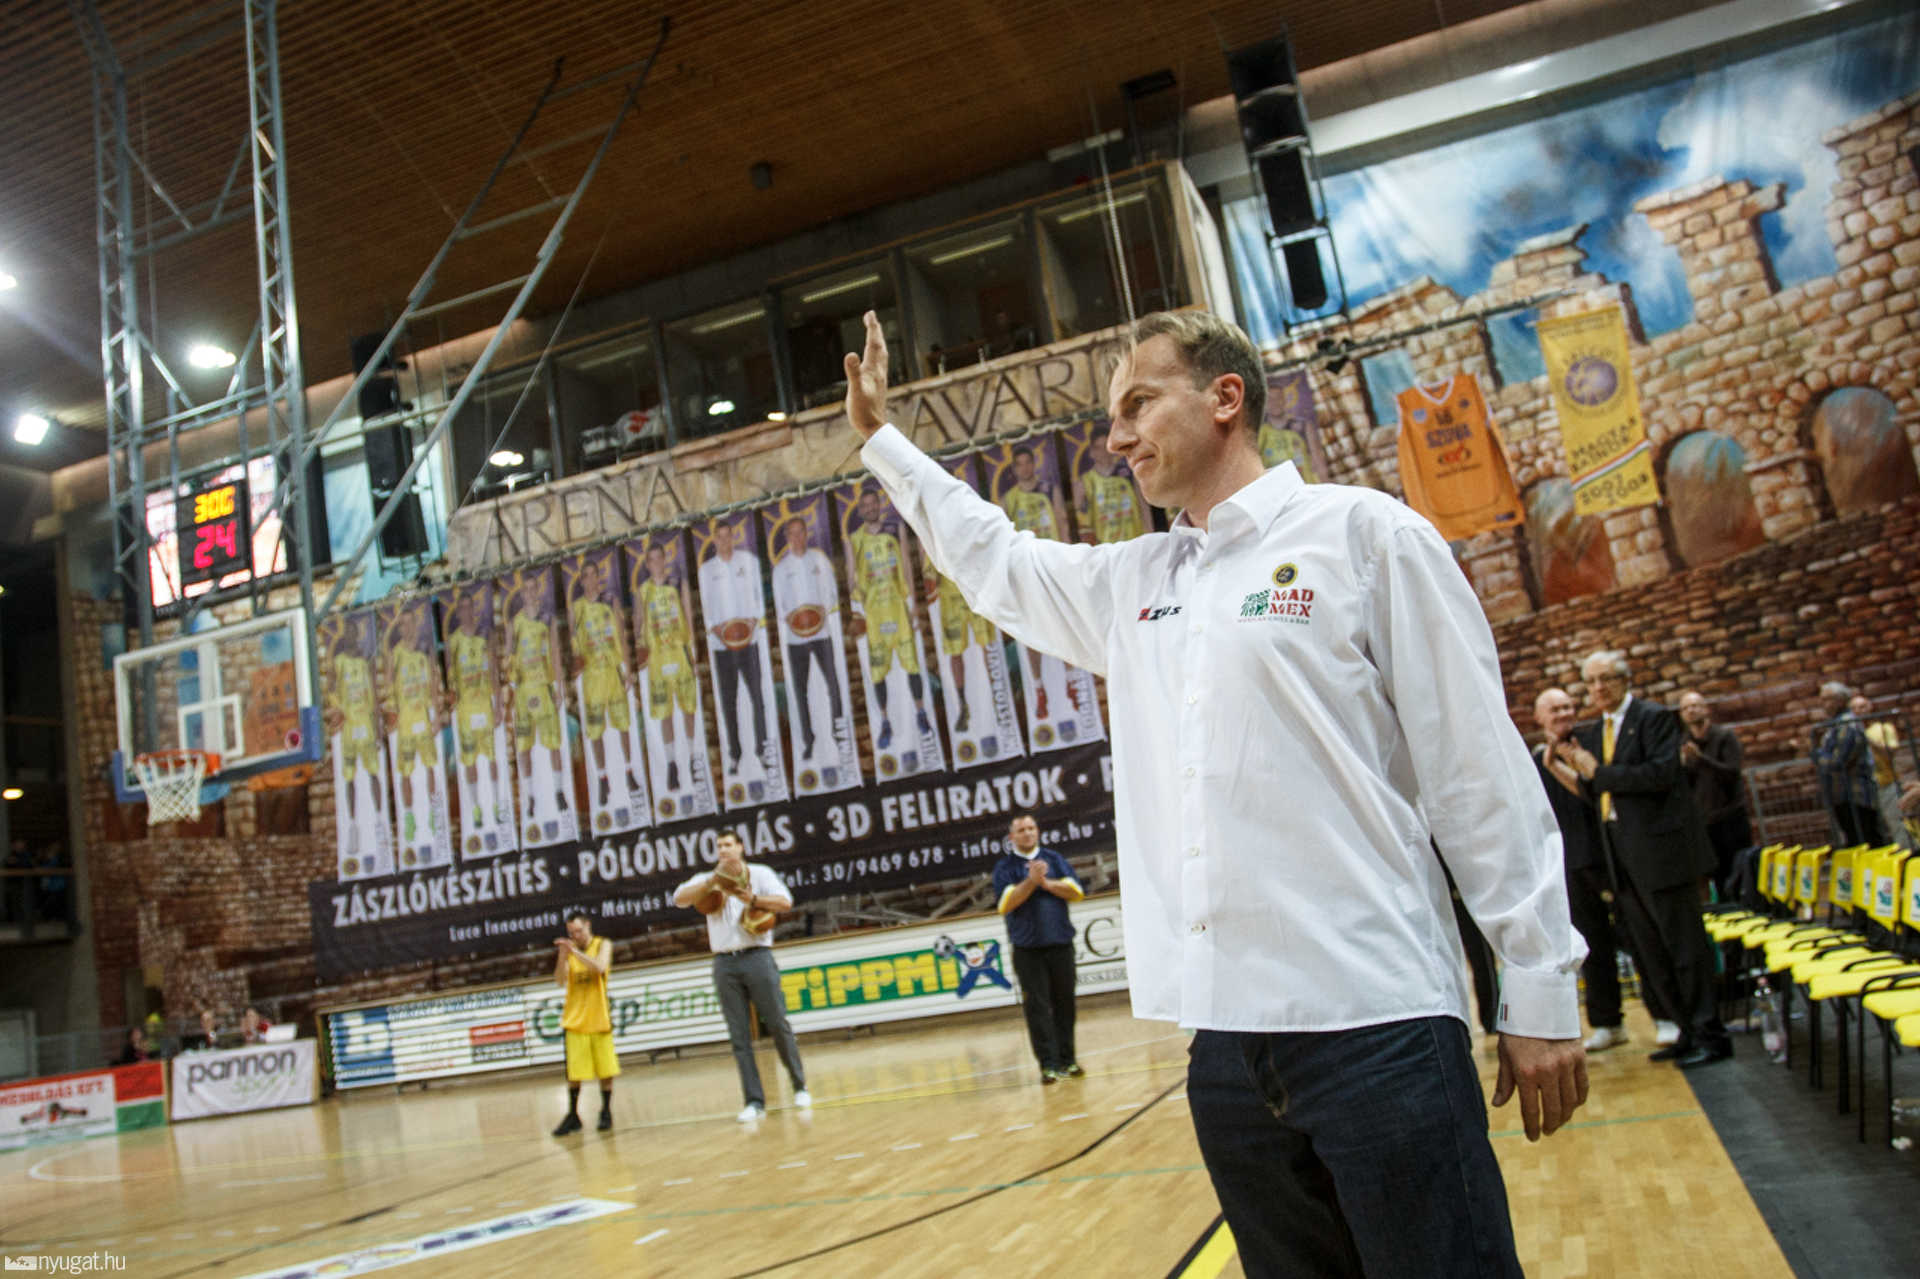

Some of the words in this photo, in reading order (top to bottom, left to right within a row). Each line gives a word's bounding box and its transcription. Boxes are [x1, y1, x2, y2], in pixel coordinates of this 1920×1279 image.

[481, 466, 688, 566] ARENA
[887, 350, 1101, 444] AVARI
[193, 520, 237, 569] 24
[1269, 603, 1312, 617] MEX
[1271, 588, 1314, 602] MAD
[331, 851, 551, 928] ZÁSZLÓKÉSZÍTÉS
[826, 802, 871, 842] 3D
[881, 765, 1067, 832] FELIRATOK
[485, 910, 559, 938] Innocente
[601, 894, 661, 918] Mátyás
[822, 852, 902, 882] 30/9469
[908, 845, 943, 868] 678
[961, 822, 1093, 860] info@ce.hu
[187, 1049, 297, 1095] pannon
